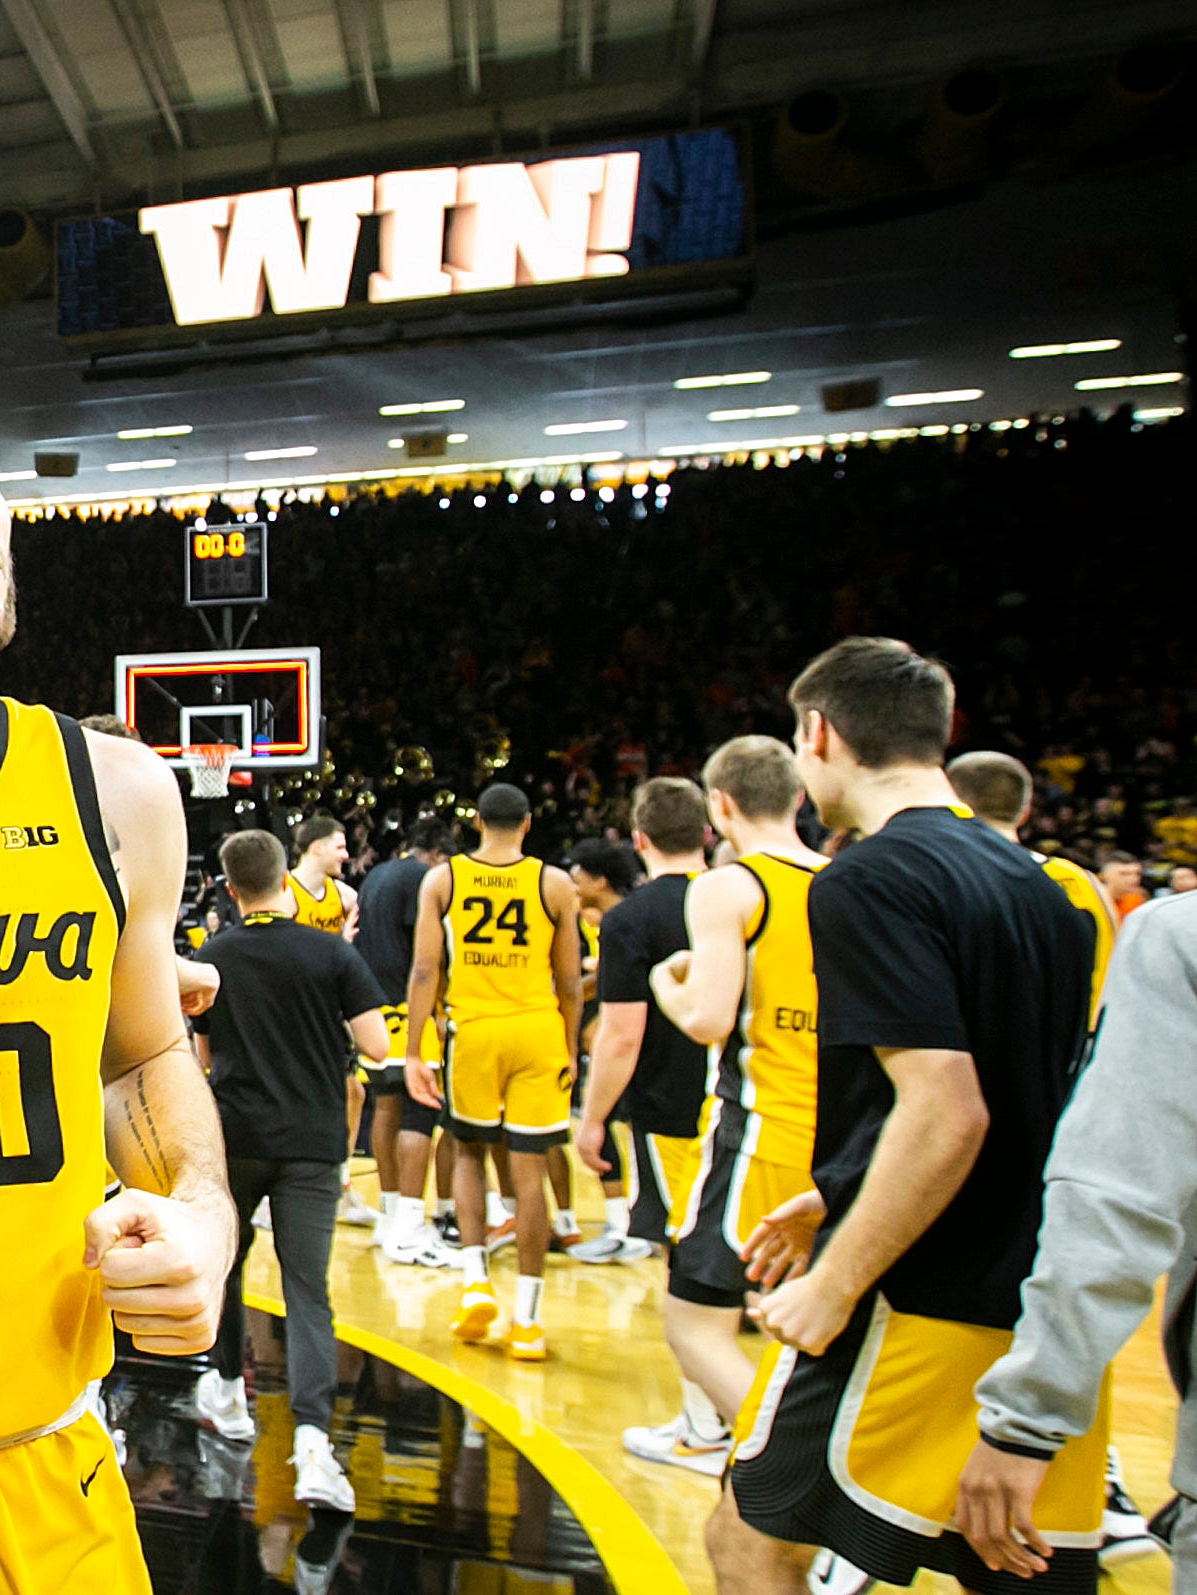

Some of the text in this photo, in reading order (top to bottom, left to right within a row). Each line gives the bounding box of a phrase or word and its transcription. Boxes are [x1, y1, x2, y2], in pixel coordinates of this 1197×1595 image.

[139, 152, 640, 326] WIN!
[473, 876, 518, 889] MURRAY
[463, 896, 529, 946] 24
[464, 951, 530, 968] EQUALITY
